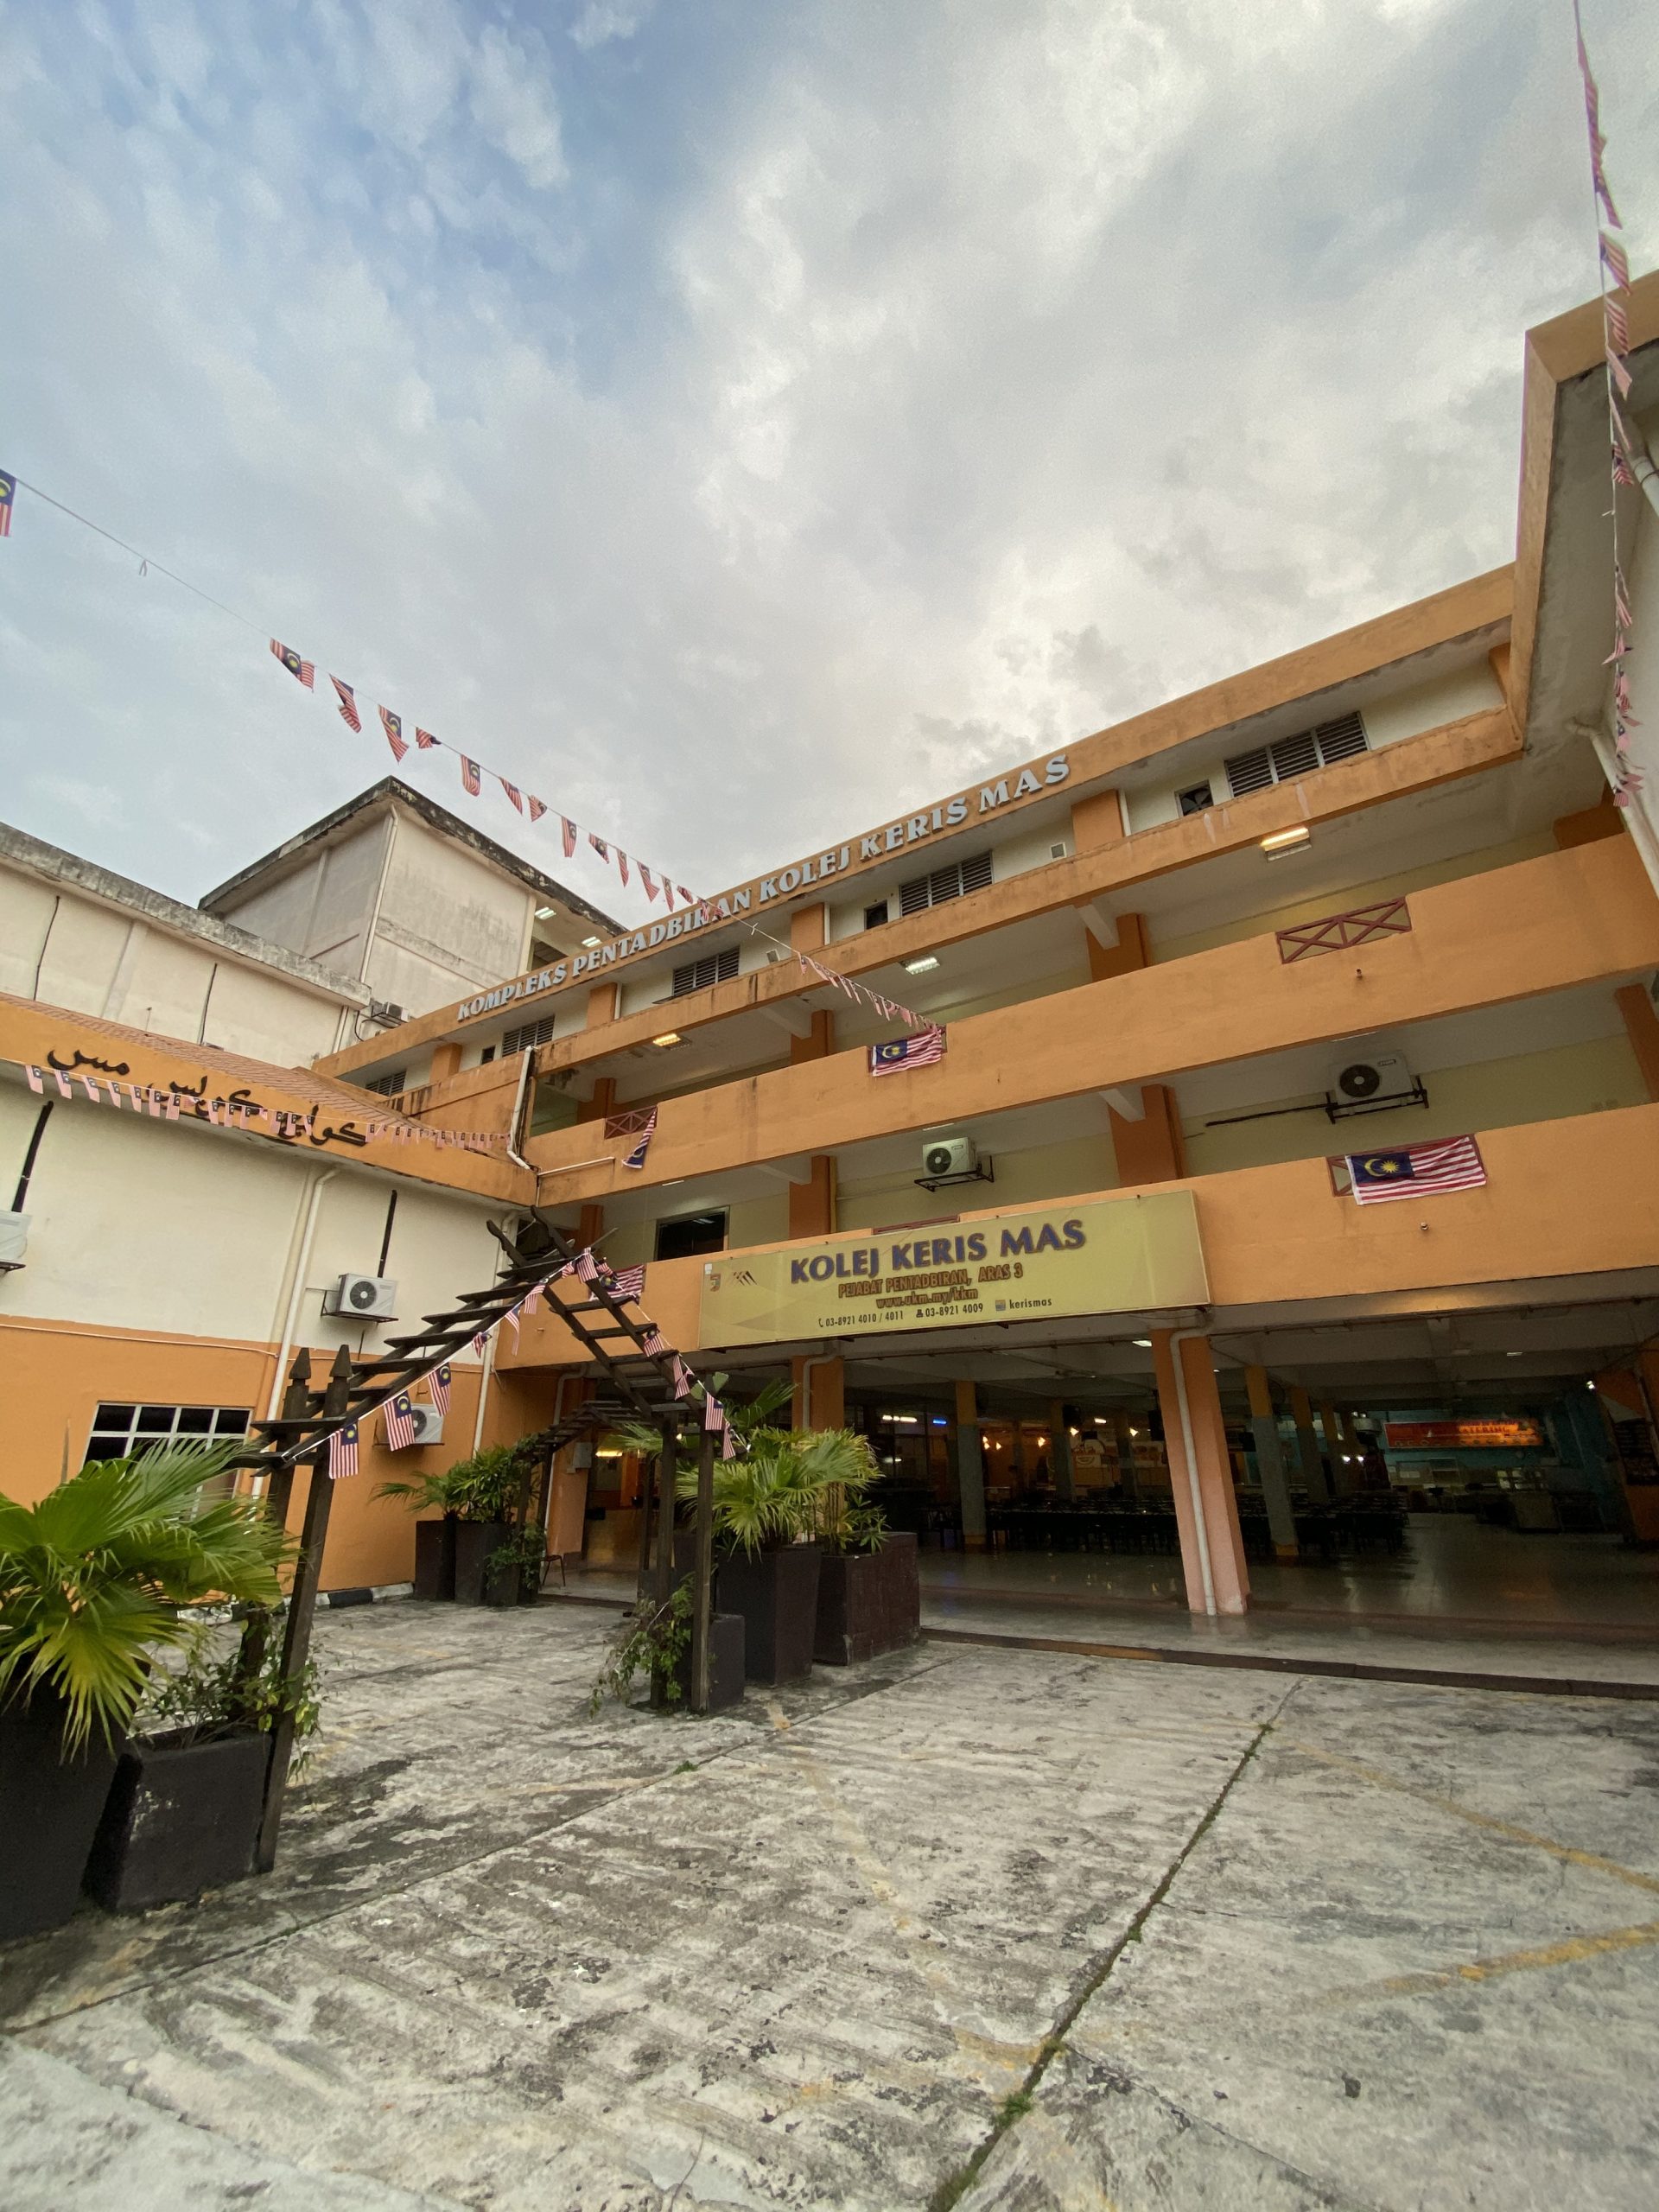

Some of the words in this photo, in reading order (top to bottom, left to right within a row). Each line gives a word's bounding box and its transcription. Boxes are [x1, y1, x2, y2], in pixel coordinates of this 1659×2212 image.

[457, 963, 568, 1022] KOMPLEKS
[572, 887, 752, 977] PENTADBIRAN
[759, 846, 851, 903] KOLEJ
[859, 797, 969, 862] KERIS
[978, 753, 1071, 814] MAS
[791, 1248, 880, 1284] KOLEJ
[891, 1232, 988, 1271] KERIS
[999, 1219, 1088, 1258] MAS
[838, 1279, 883, 1298] PEJABAT
[886, 1268, 972, 1293] PENTADBIRAN,
[978, 1263, 1011, 1282] ARAS
[1014, 1262, 1024, 1279] 3
[876, 1287, 979, 1310] www.ukm.my/kkm
[925, 1305, 959, 1318] 03-8921
[963, 1302, 984, 1314] 4009
[1009, 1298, 1052, 1310] kerismas
[825, 1315, 855, 1327] 03-8921
[858, 1313, 877, 1325] 4010
[884, 1310, 904, 1322] 4011
